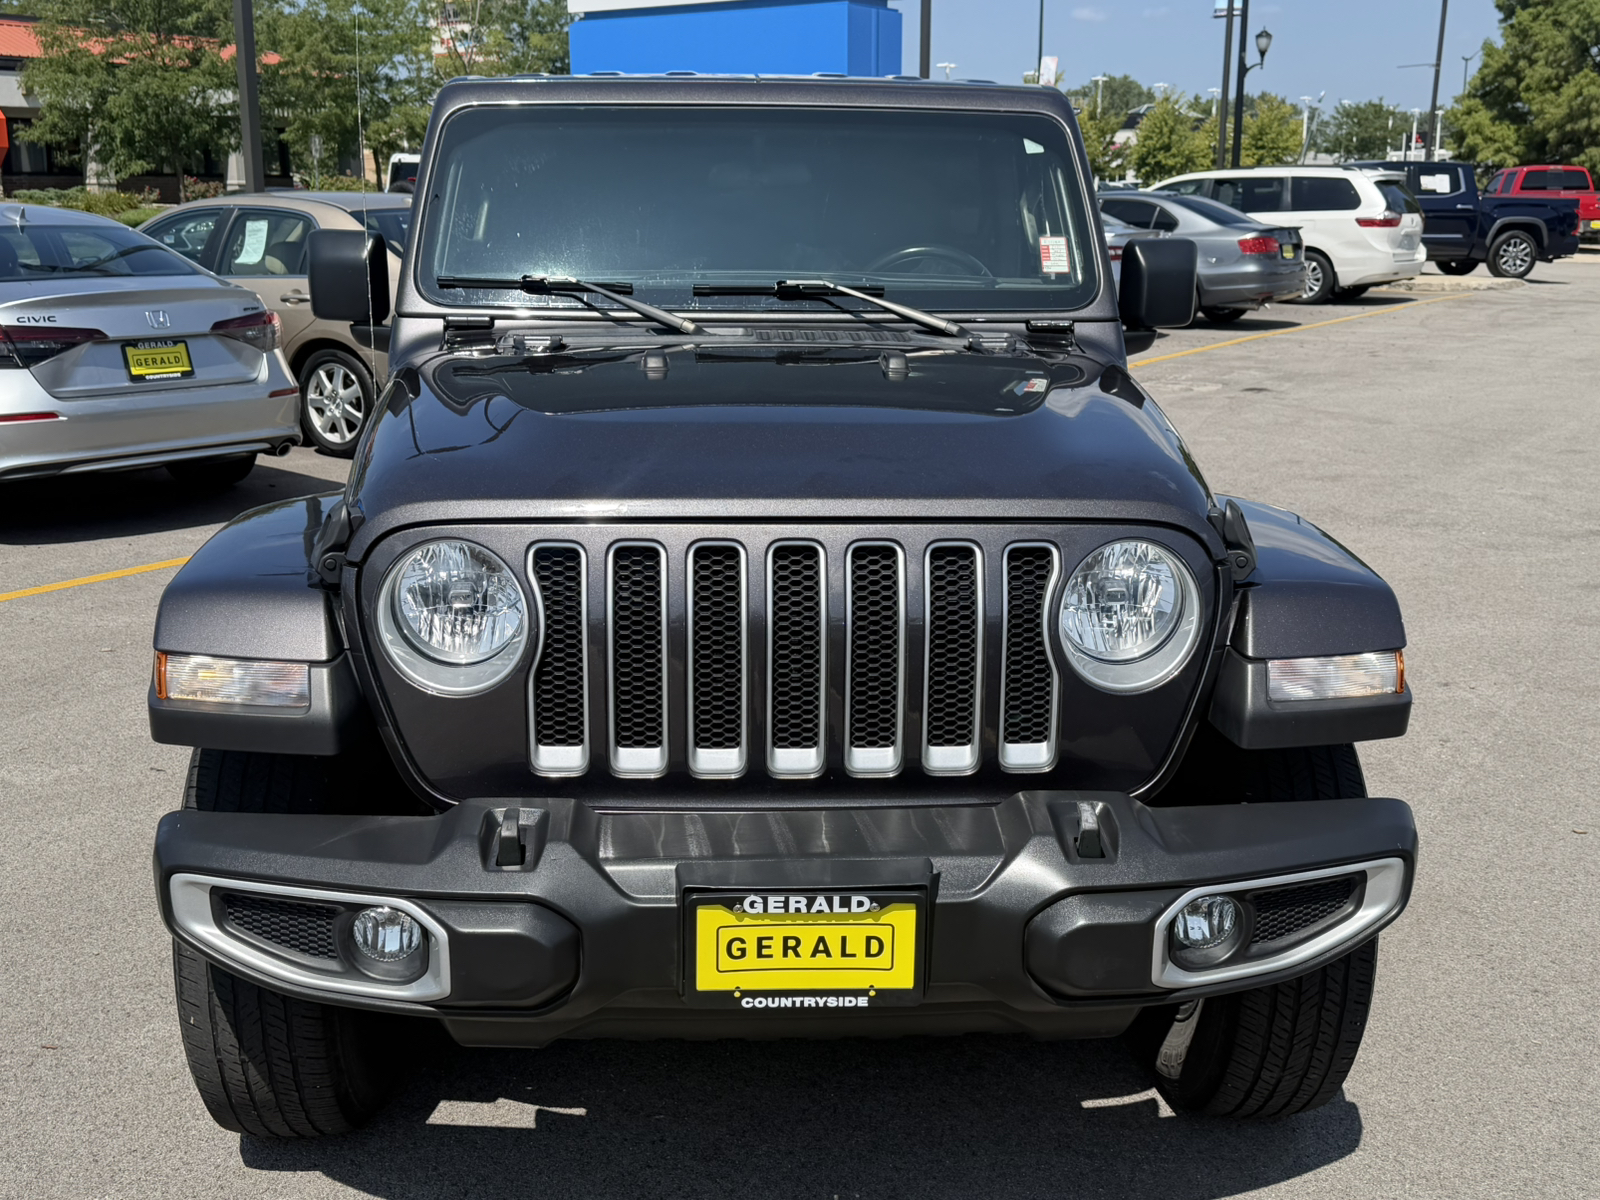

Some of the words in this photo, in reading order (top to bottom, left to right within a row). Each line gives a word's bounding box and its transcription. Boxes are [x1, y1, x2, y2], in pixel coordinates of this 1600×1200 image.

[16, 315, 57, 324] CIVIC
[137, 341, 174, 349] GERALD
[135, 355, 181, 367] GERALD
[743, 895, 870, 914] GERALD
[726, 936, 885, 960] GERALD
[741, 997, 868, 1008] COUNTRYSIDE
